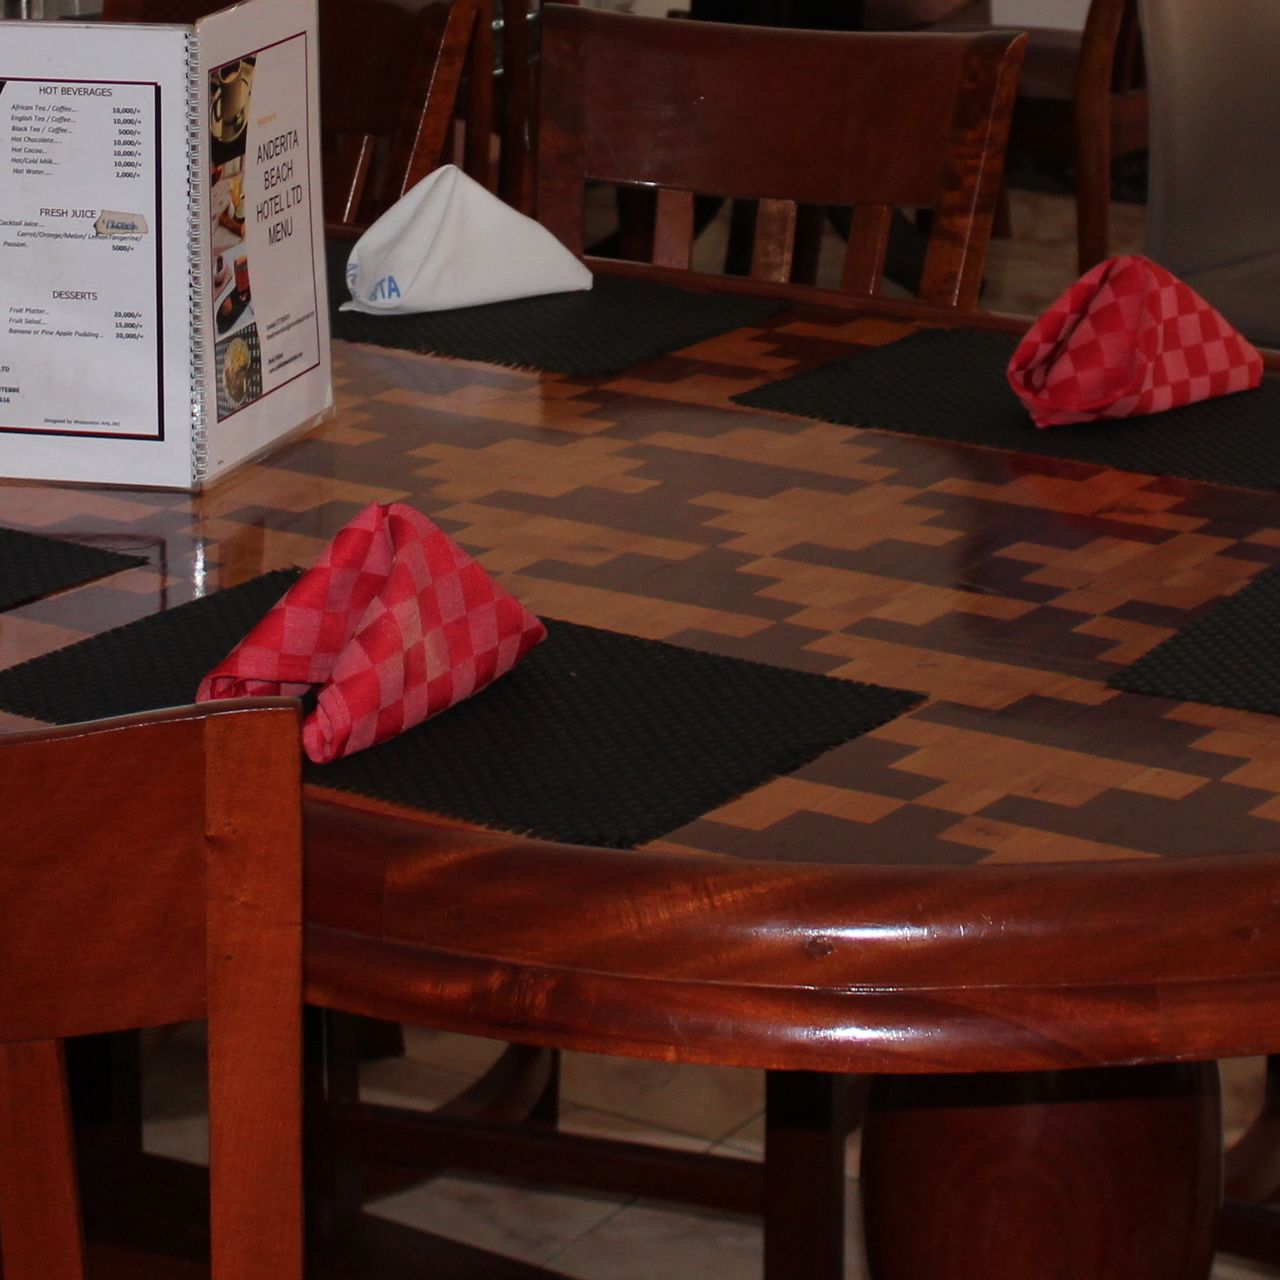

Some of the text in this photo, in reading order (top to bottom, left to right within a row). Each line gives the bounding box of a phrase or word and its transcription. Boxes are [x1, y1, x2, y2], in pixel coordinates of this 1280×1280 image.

[39, 86, 112, 97] HOT BEVERAGES
[257, 129, 299, 165] ANDERITA
[264, 159, 293, 190] BEACH
[257, 184, 302, 222] HOTEL LTD
[40, 208, 96, 218] FRESH JUICE
[269, 218, 293, 246] MENU
[52, 290, 98, 300] DESSERTS
[55, 330, 73, 338] Apple
